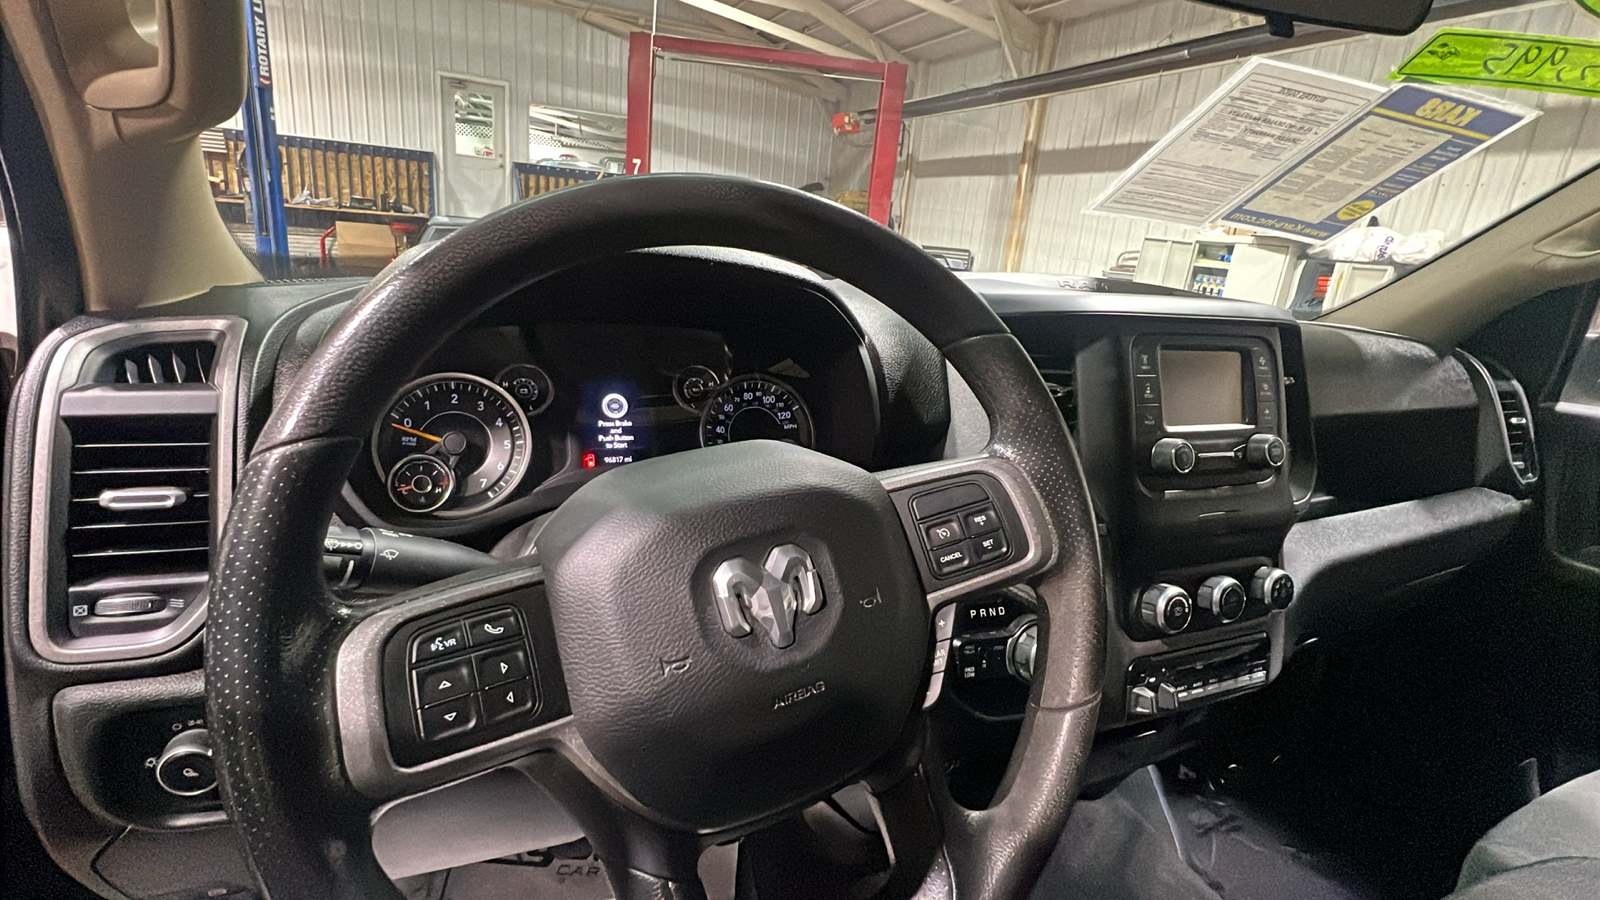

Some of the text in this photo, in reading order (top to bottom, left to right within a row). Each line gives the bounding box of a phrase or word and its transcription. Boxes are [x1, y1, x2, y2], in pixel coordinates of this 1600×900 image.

[254, 15, 270, 77] ROTARY
[632, 158, 641, 175] 7
[450, 393, 459, 404] 2
[743, 392, 753, 401] 80
[762, 395, 776, 404] 100
[423, 400, 431, 411] 1
[477, 400, 485, 411] 3
[724, 404, 734, 412] 60
[777, 411, 791, 420] 120
[403, 418, 412, 429] 0
[495, 417, 503, 427] 4
[598, 419, 633, 427] Press Brake
[715, 426, 725, 434] 40
[598, 434, 614, 442] Push
[503, 439, 511, 449] 5
[603, 455, 633, 464] 96817 mi
[497, 460, 504, 471] 6
[479, 478, 487, 488] 7
[973, 515, 987, 524] RES
[982, 538, 994, 548] SET
[940, 551, 963, 563] CANCEL
[444, 638, 457, 648] VR
[772, 681, 826, 710] AIRBAG
[556, 864, 601, 877] CAR
